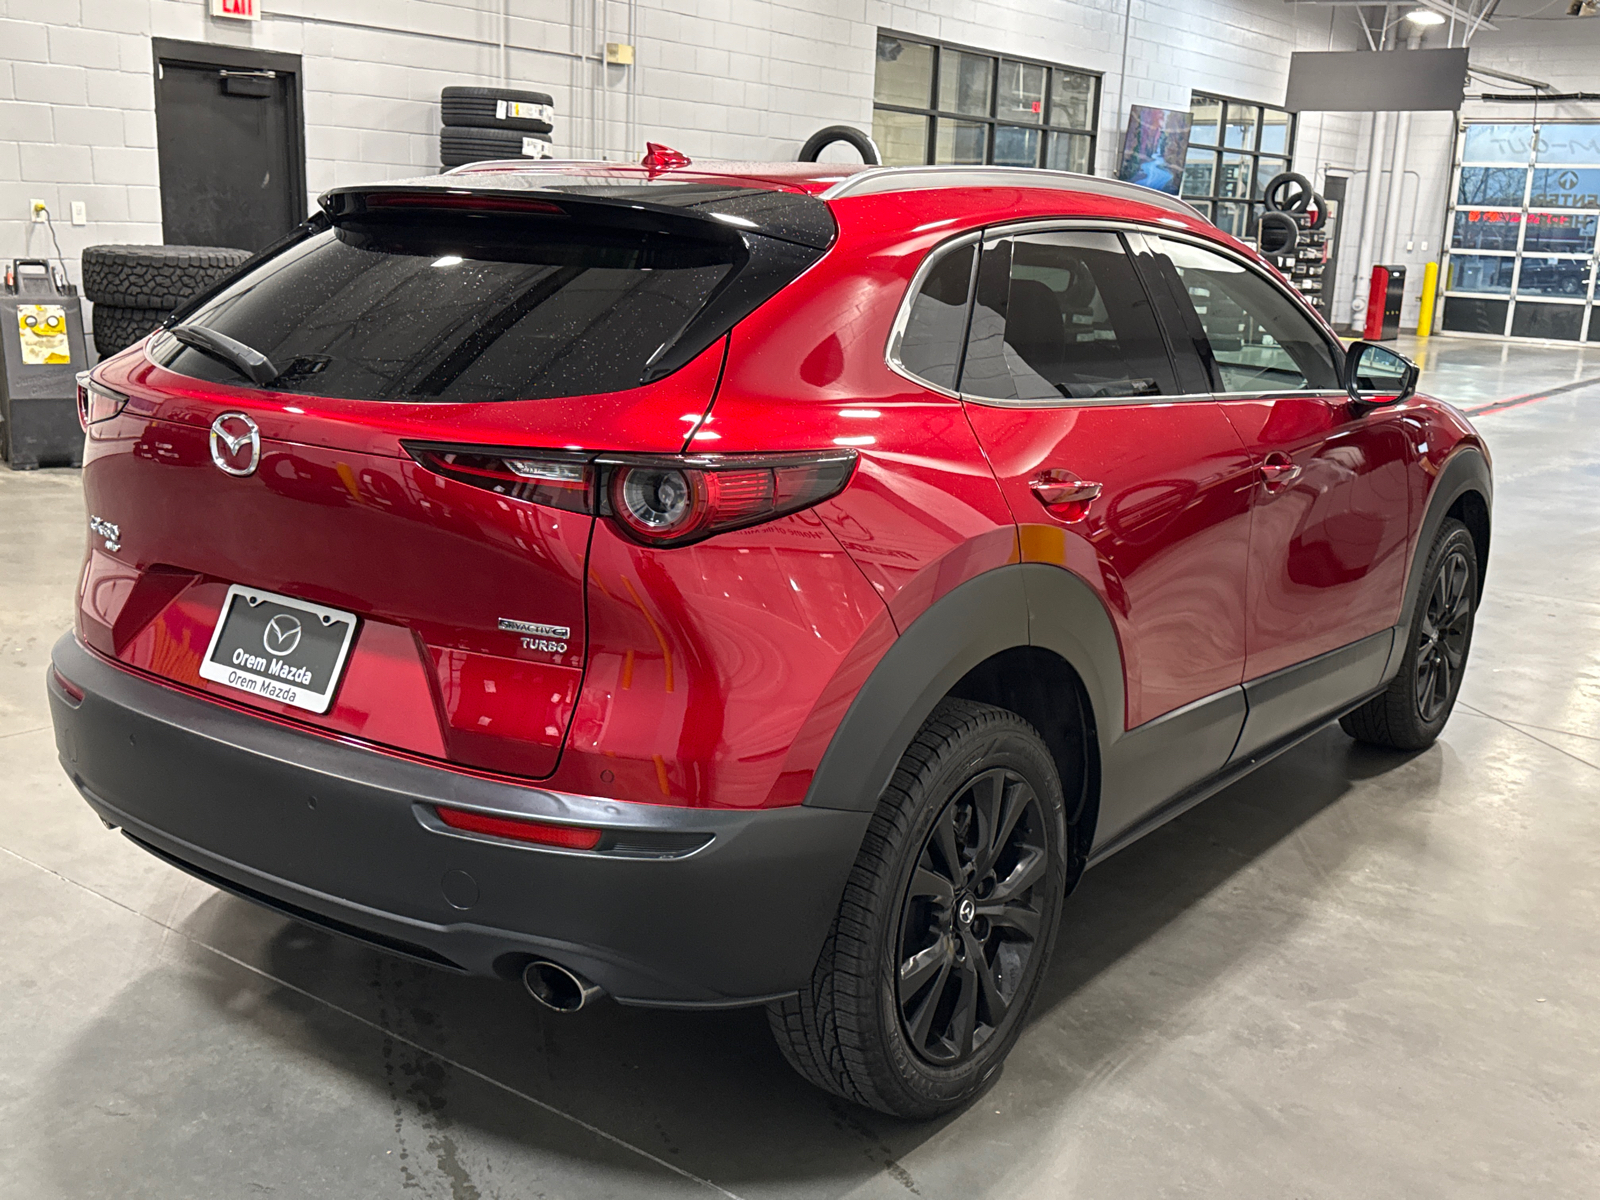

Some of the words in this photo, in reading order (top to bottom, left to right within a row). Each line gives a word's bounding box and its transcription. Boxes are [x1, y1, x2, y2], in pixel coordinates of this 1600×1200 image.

[520, 637, 568, 653] TURBO
[232, 647, 267, 672] Orem
[267, 658, 313, 685] Mazda
[228, 670, 257, 691] Orem
[259, 680, 297, 702] Mazda
